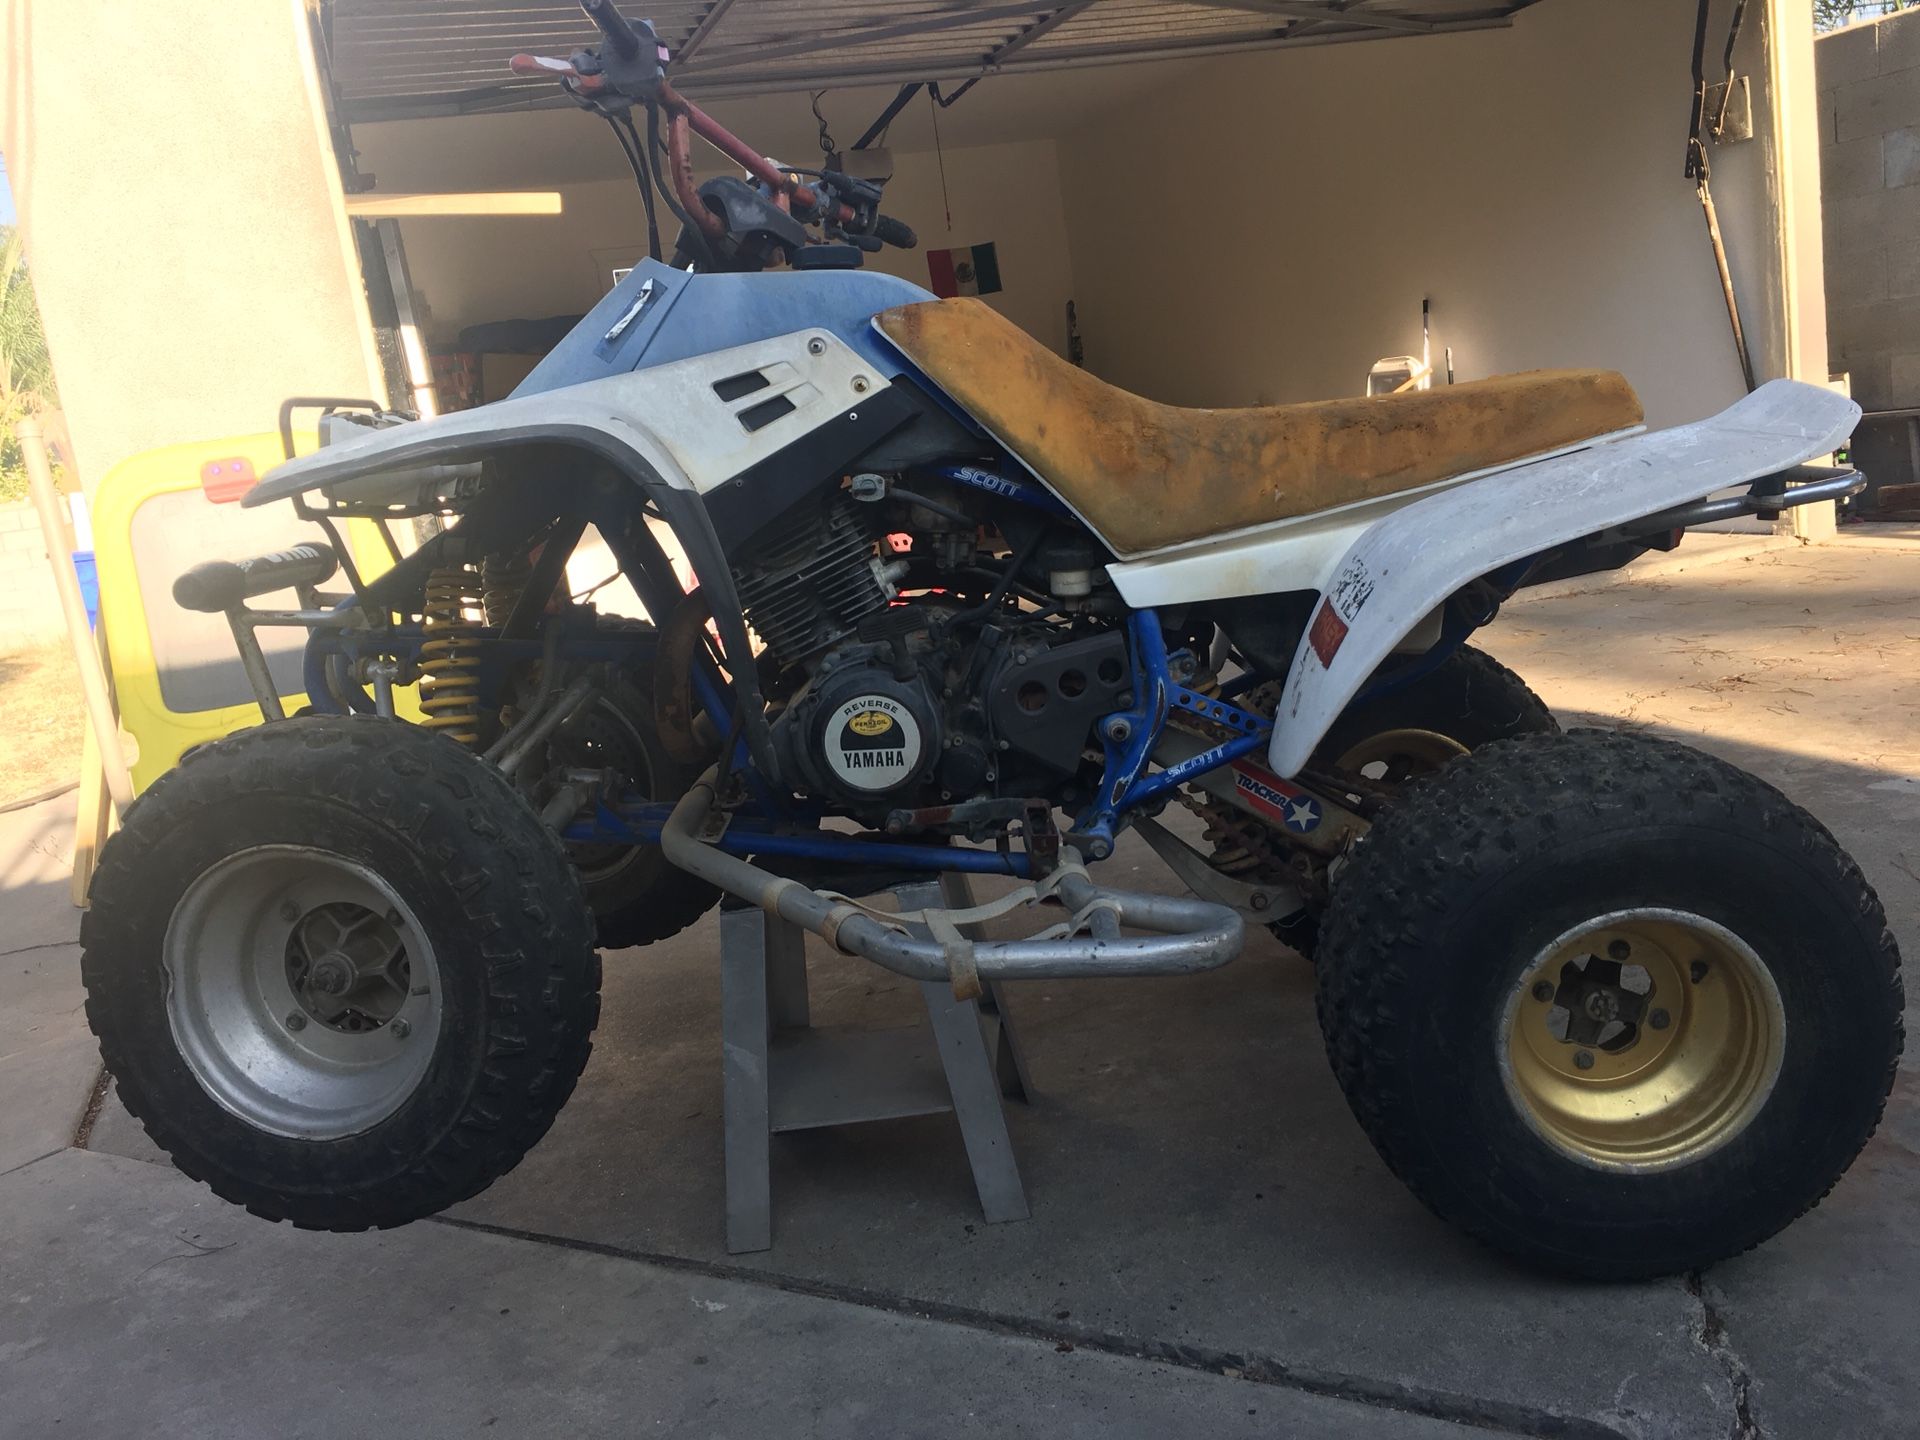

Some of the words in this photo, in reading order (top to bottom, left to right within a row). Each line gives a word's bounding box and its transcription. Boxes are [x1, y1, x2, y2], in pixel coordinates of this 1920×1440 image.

[953, 466, 1022, 496] SCOTT
[844, 699, 898, 716] REVERSE
[844, 751, 904, 768] YAMAHA
[1167, 745, 1225, 777] SCOTT
[1236, 774, 1292, 809] TRACKER
